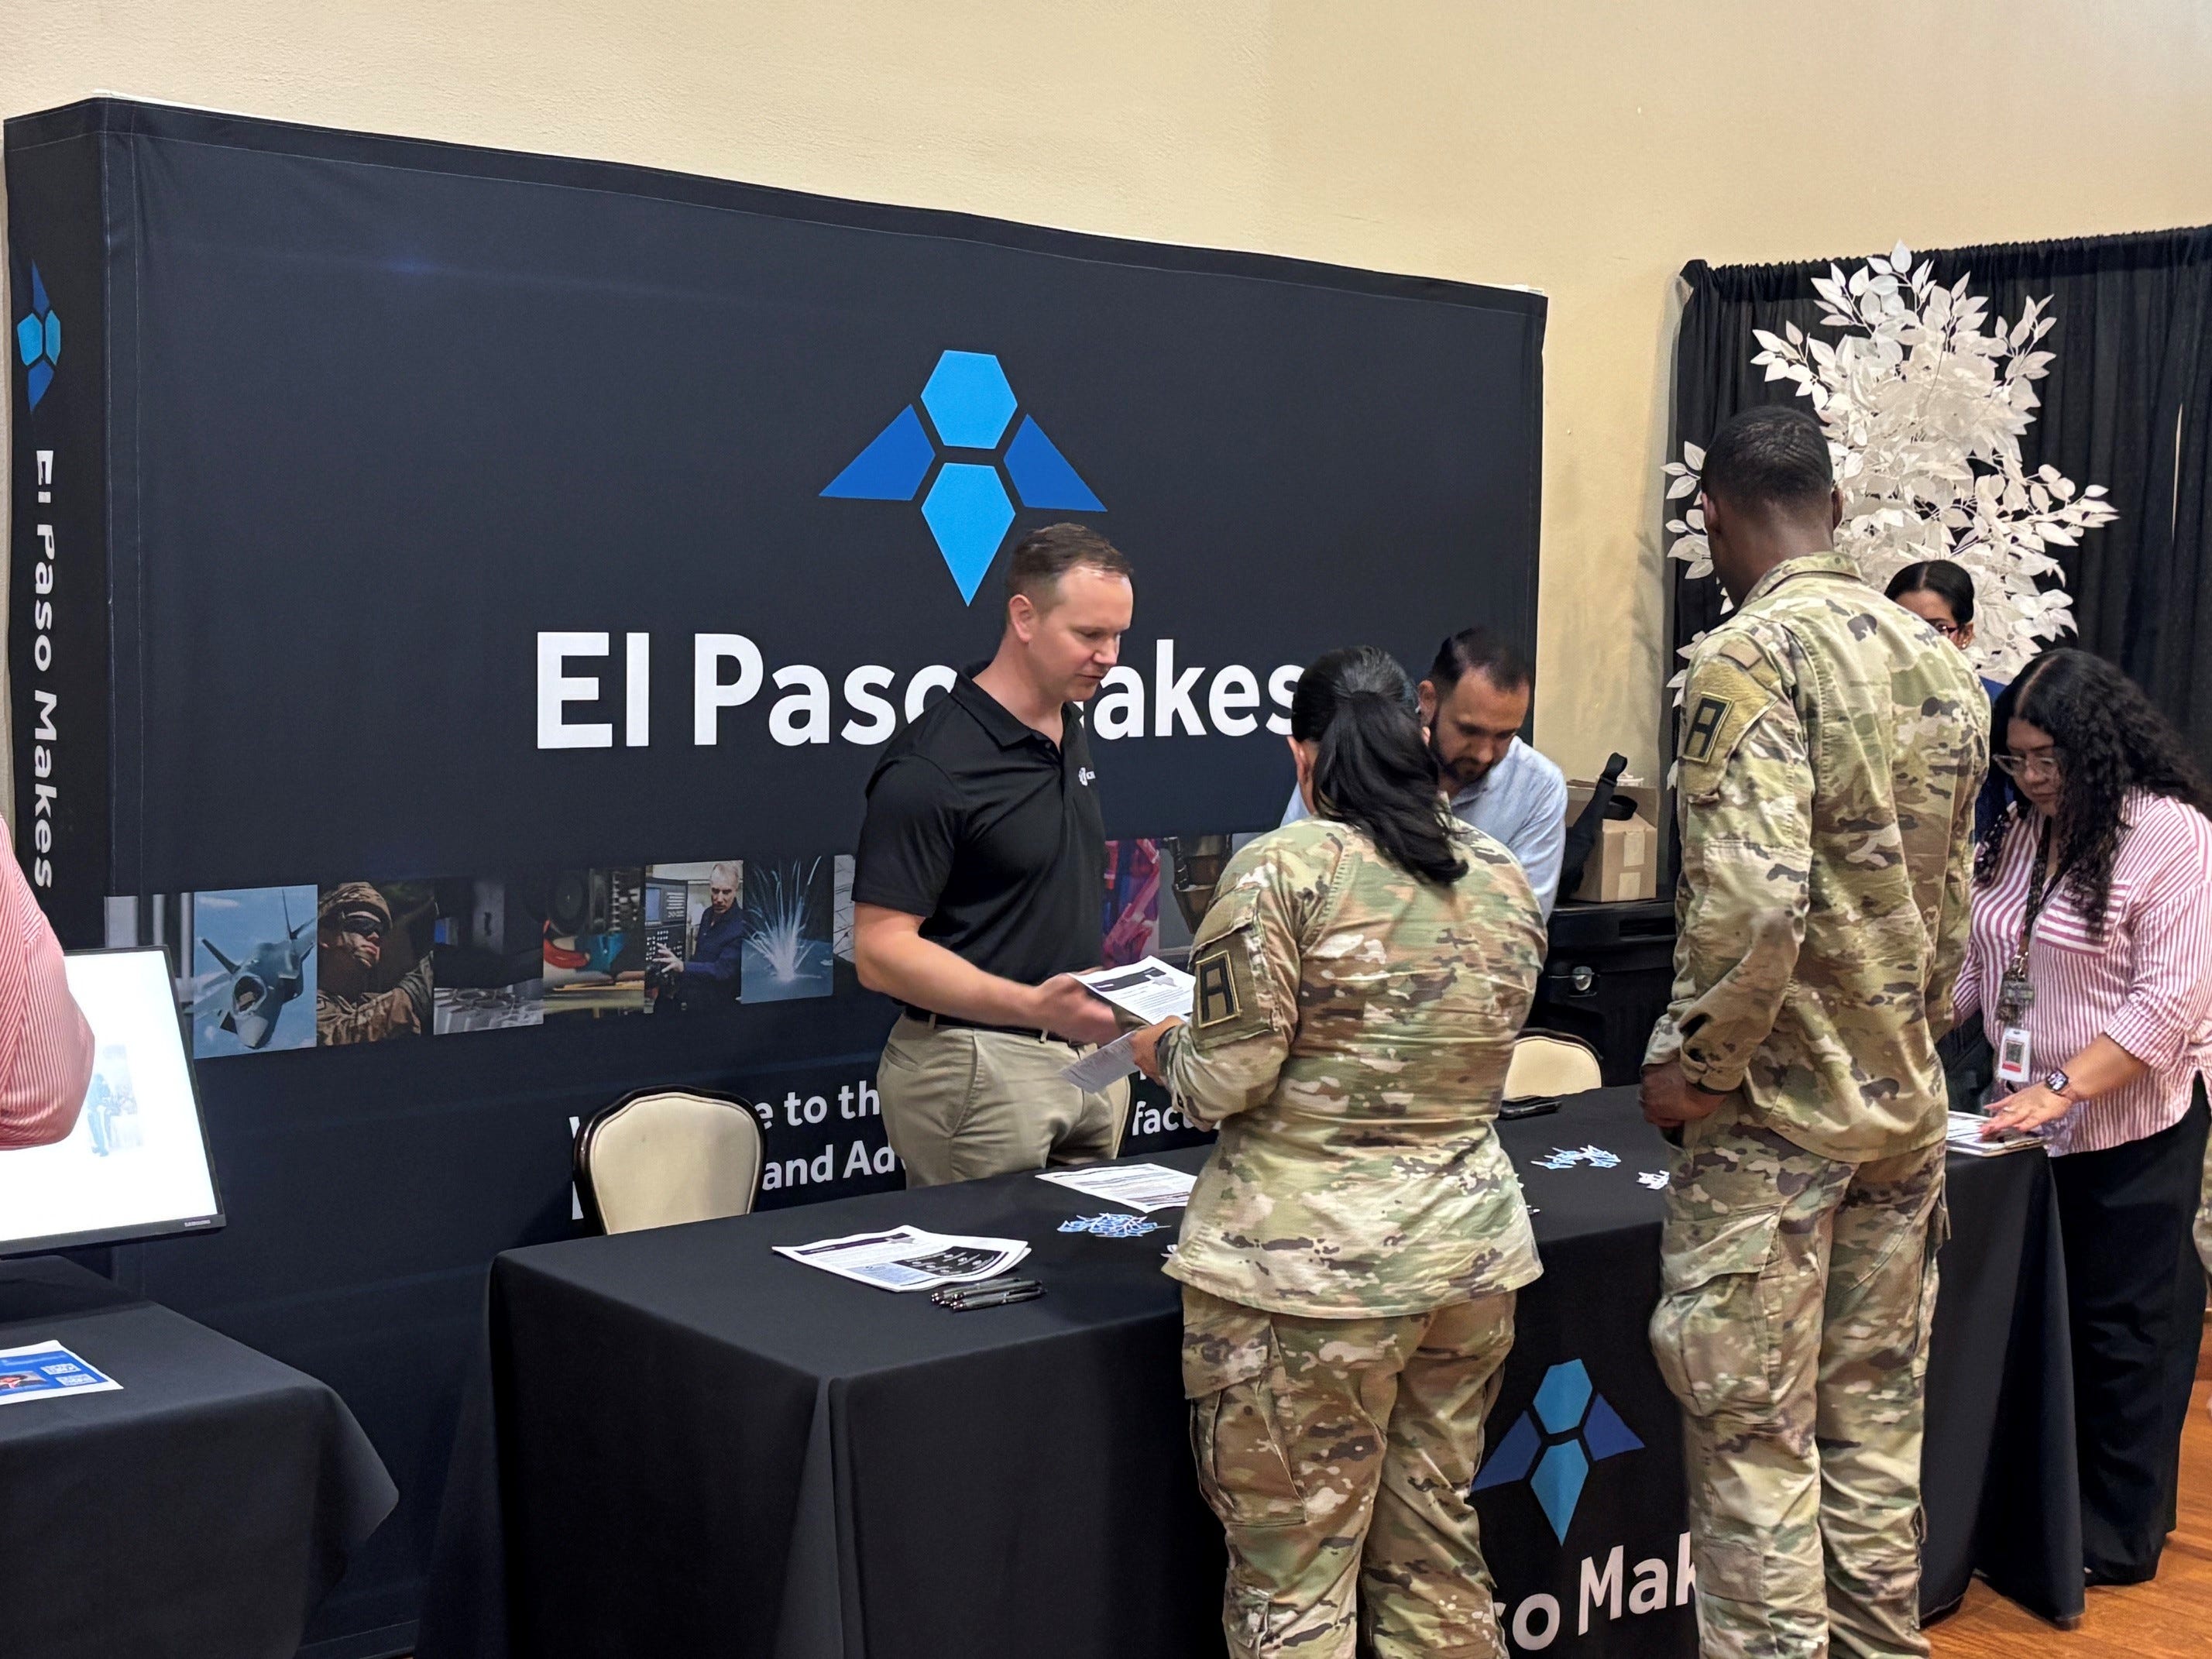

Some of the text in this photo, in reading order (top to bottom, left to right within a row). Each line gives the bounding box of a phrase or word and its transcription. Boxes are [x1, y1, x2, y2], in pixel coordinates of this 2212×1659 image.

[35, 450, 57, 888] El Paso Makes
[537, 631, 650, 750] El
[1073, 638, 1305, 740] akes
[784, 1091, 827, 1126] to
[837, 1080, 881, 1120] th
[762, 1144, 833, 1190] and
[843, 1140, 905, 1179] Ad
[1578, 1533, 1696, 1637] Mak
